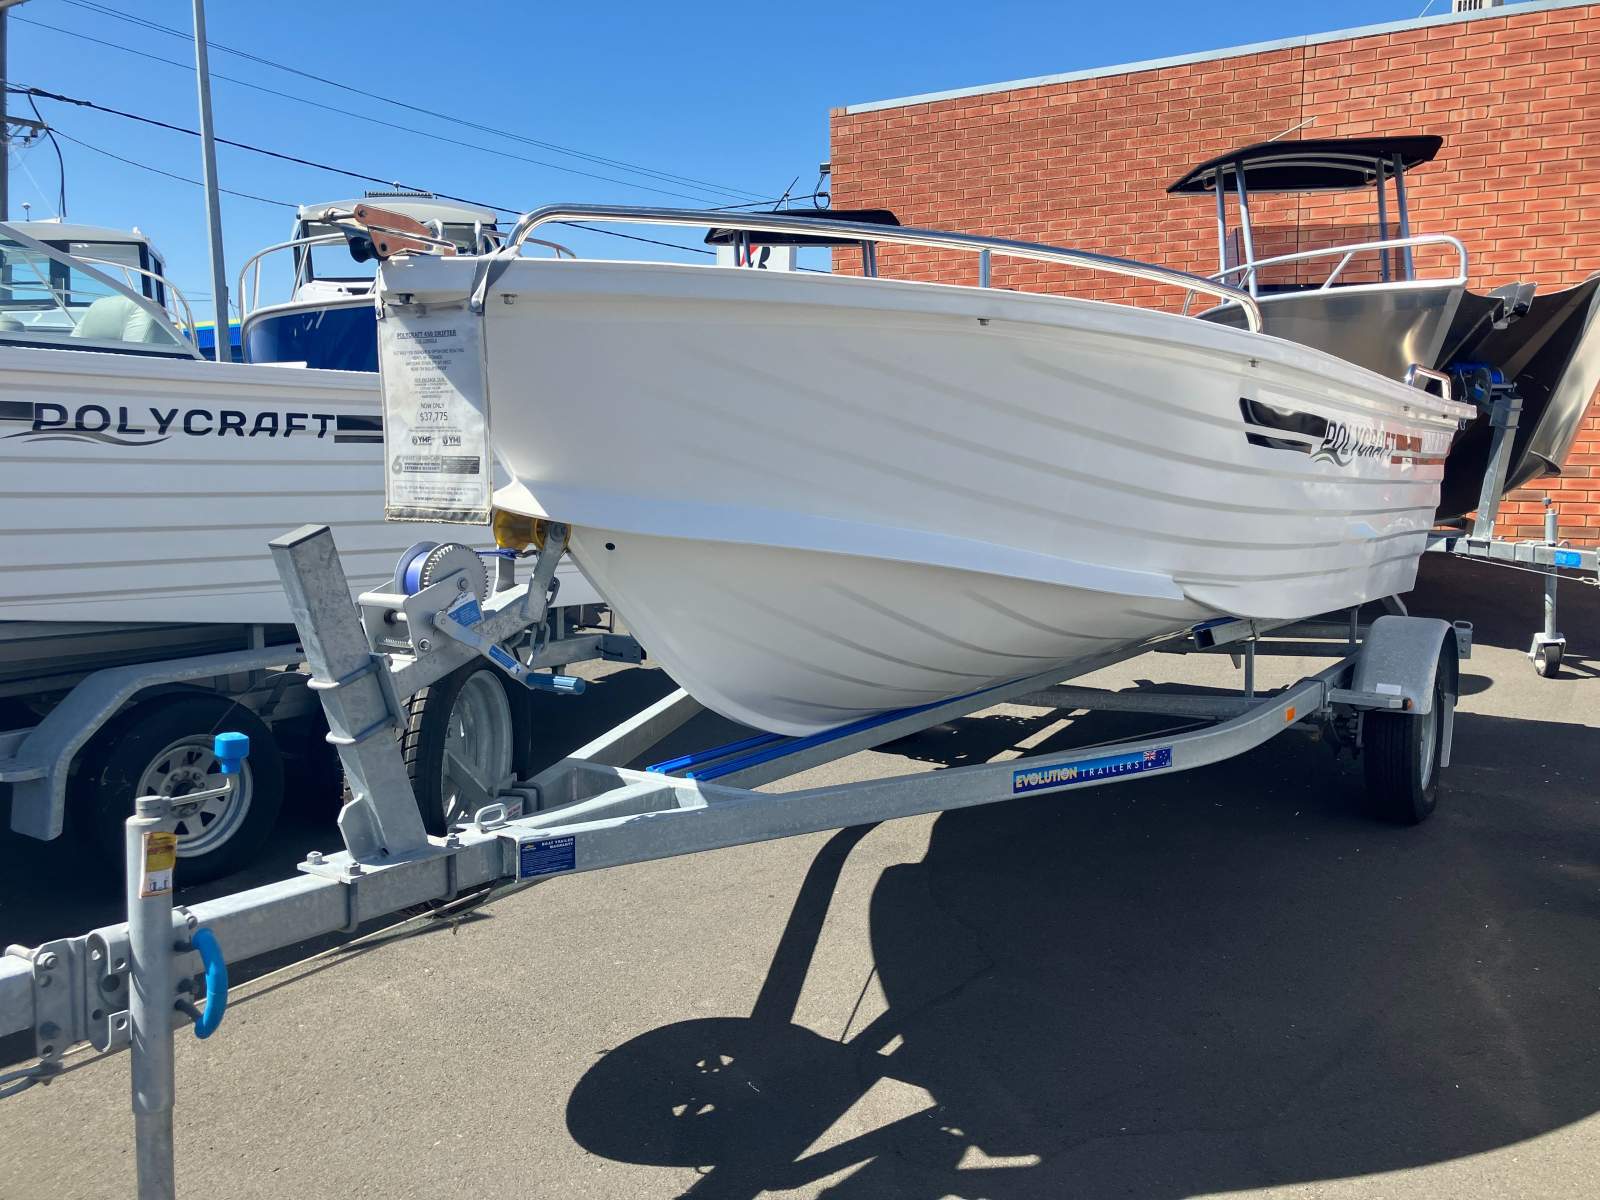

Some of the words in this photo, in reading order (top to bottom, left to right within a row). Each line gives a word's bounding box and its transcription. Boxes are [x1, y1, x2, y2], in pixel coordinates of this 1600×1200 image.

[396, 331, 423, 339] POLYCRAFT
[434, 329, 457, 337] DRIFTER
[32, 402, 336, 439] POLYCRAFT
[419, 411, 448, 422] $37,775
[1320, 419, 1396, 458] POLYCRAFT
[1015, 767, 1079, 788] EVOLUTION
[1082, 760, 1140, 777] TRAILERS
